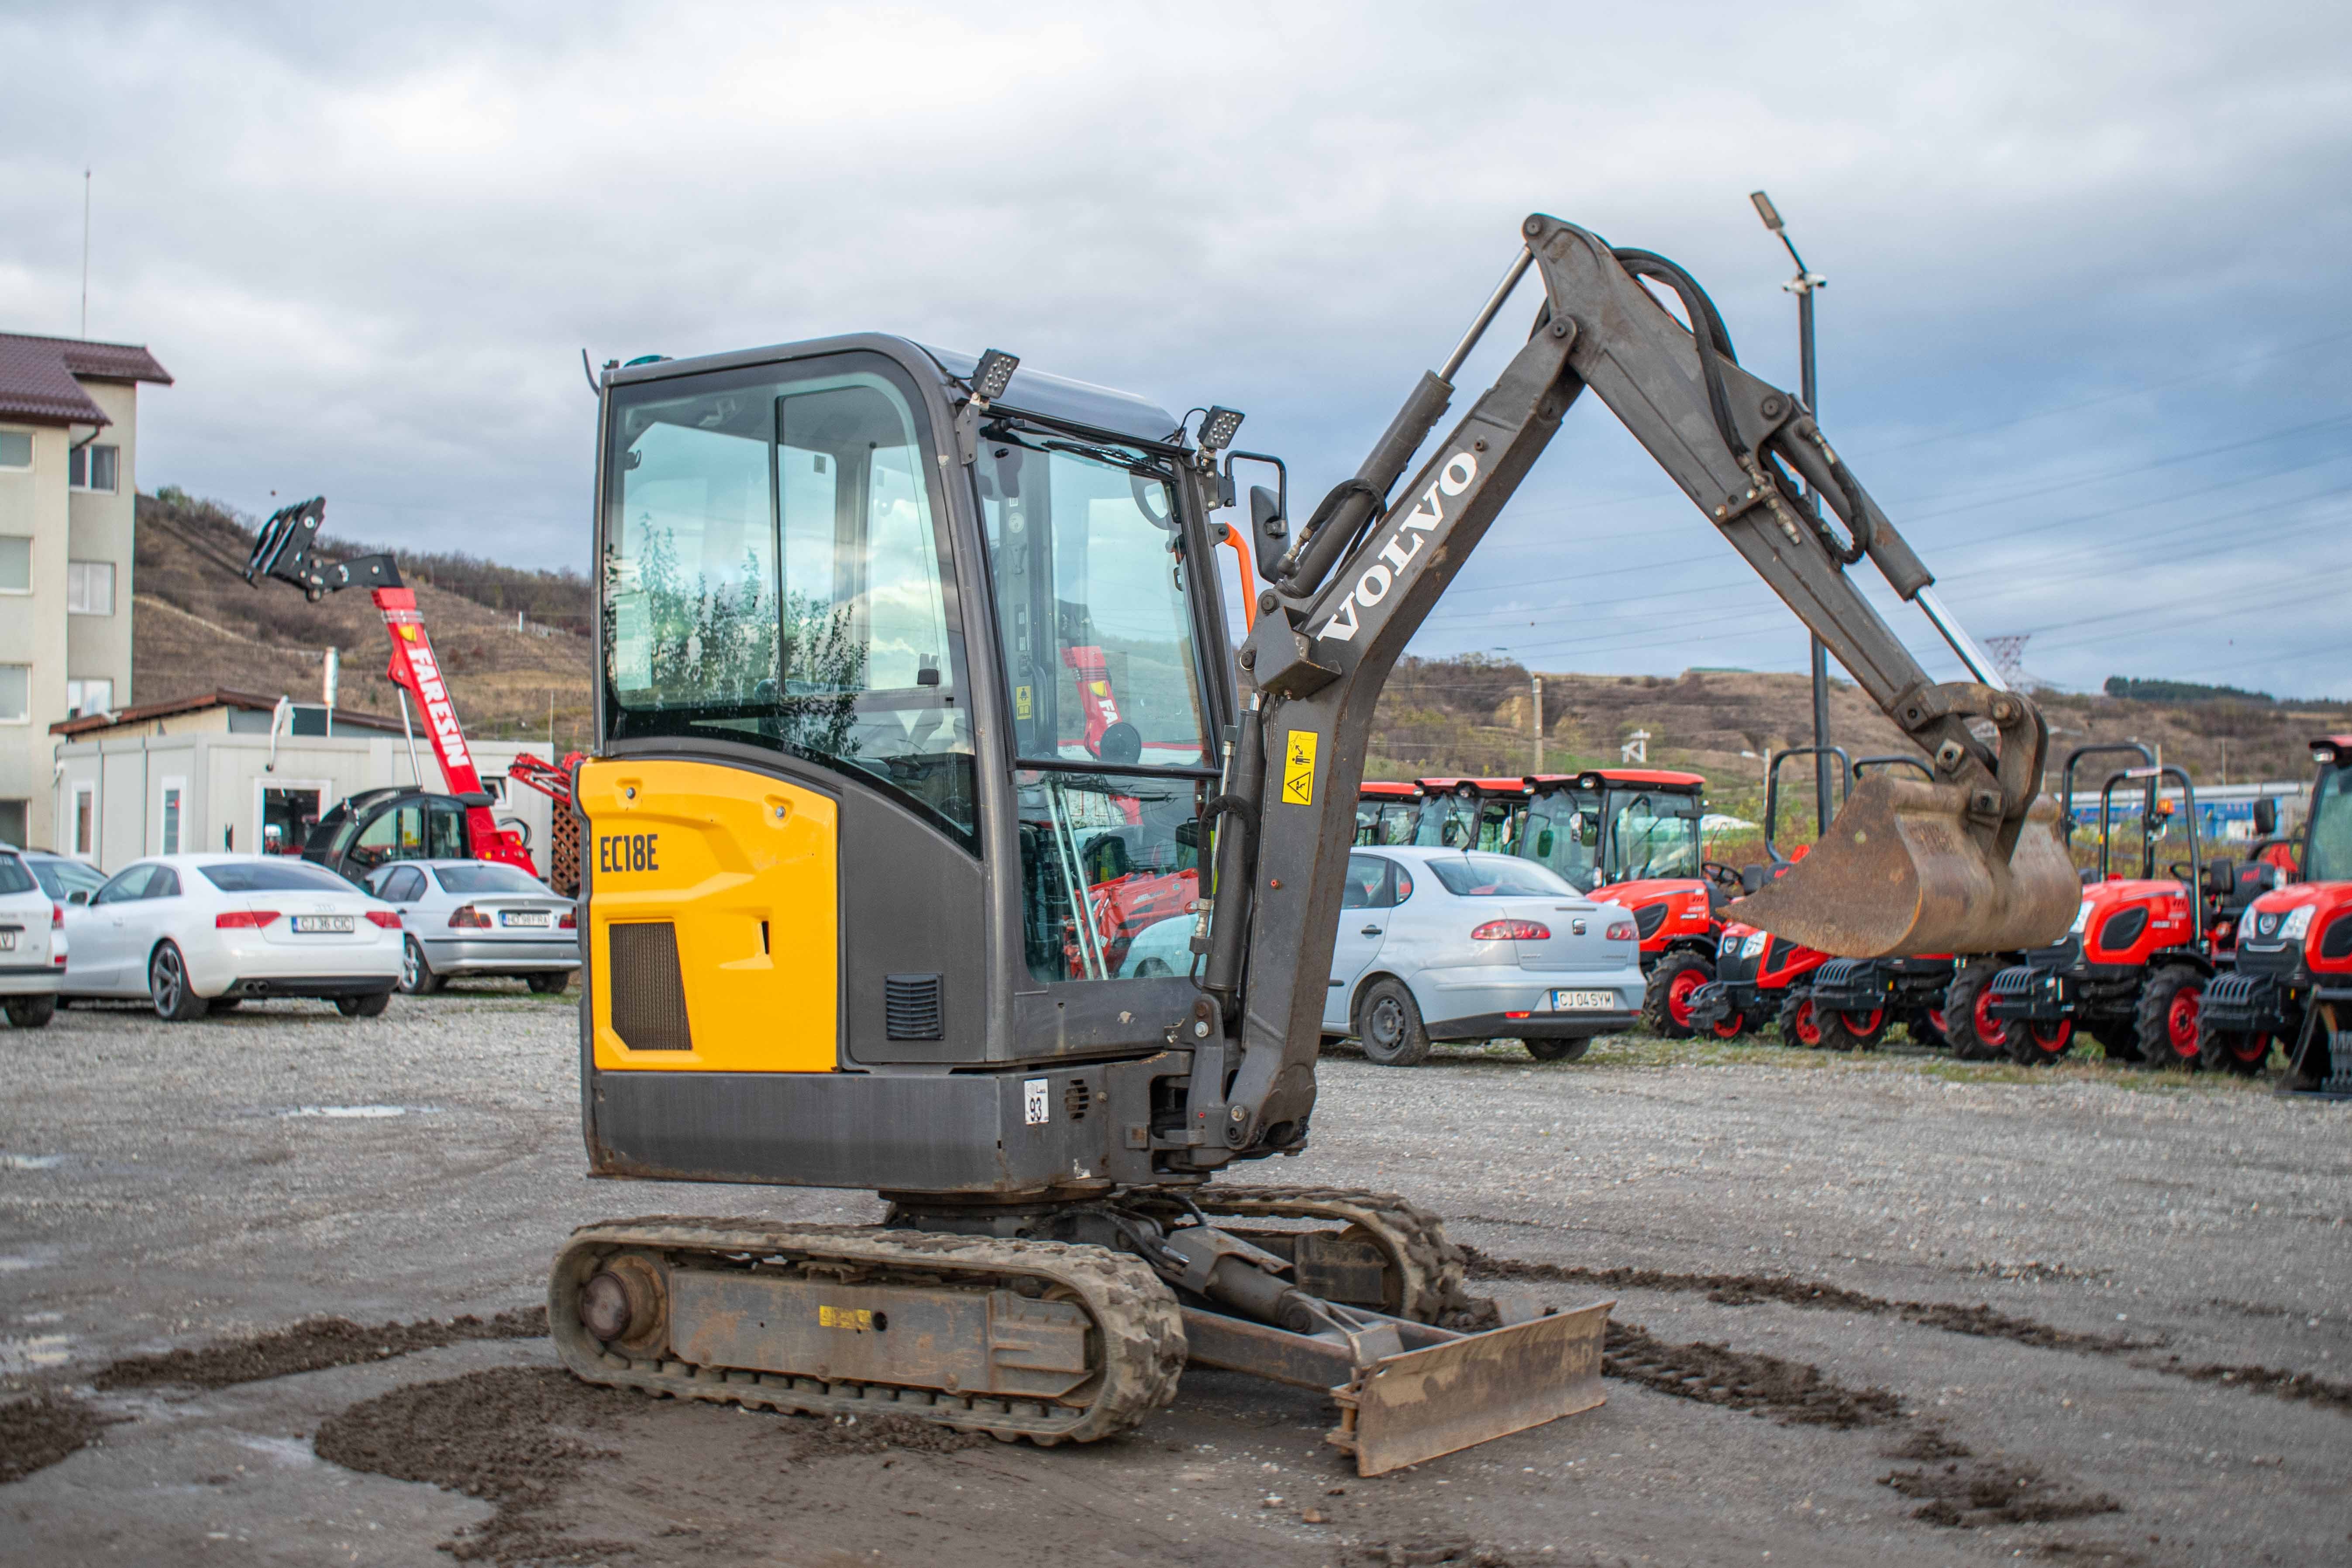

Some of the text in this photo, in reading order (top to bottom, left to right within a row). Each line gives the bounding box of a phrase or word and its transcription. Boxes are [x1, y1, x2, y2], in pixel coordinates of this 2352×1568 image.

[1316, 452, 1477, 641] VOLVO
[407, 648, 470, 767] FARESIN
[1098, 699, 1118, 728] FA
[600, 834, 658, 872] EC18E
[1560, 993, 1573, 1006] CJ
[1030, 1096, 1041, 1122] 93
